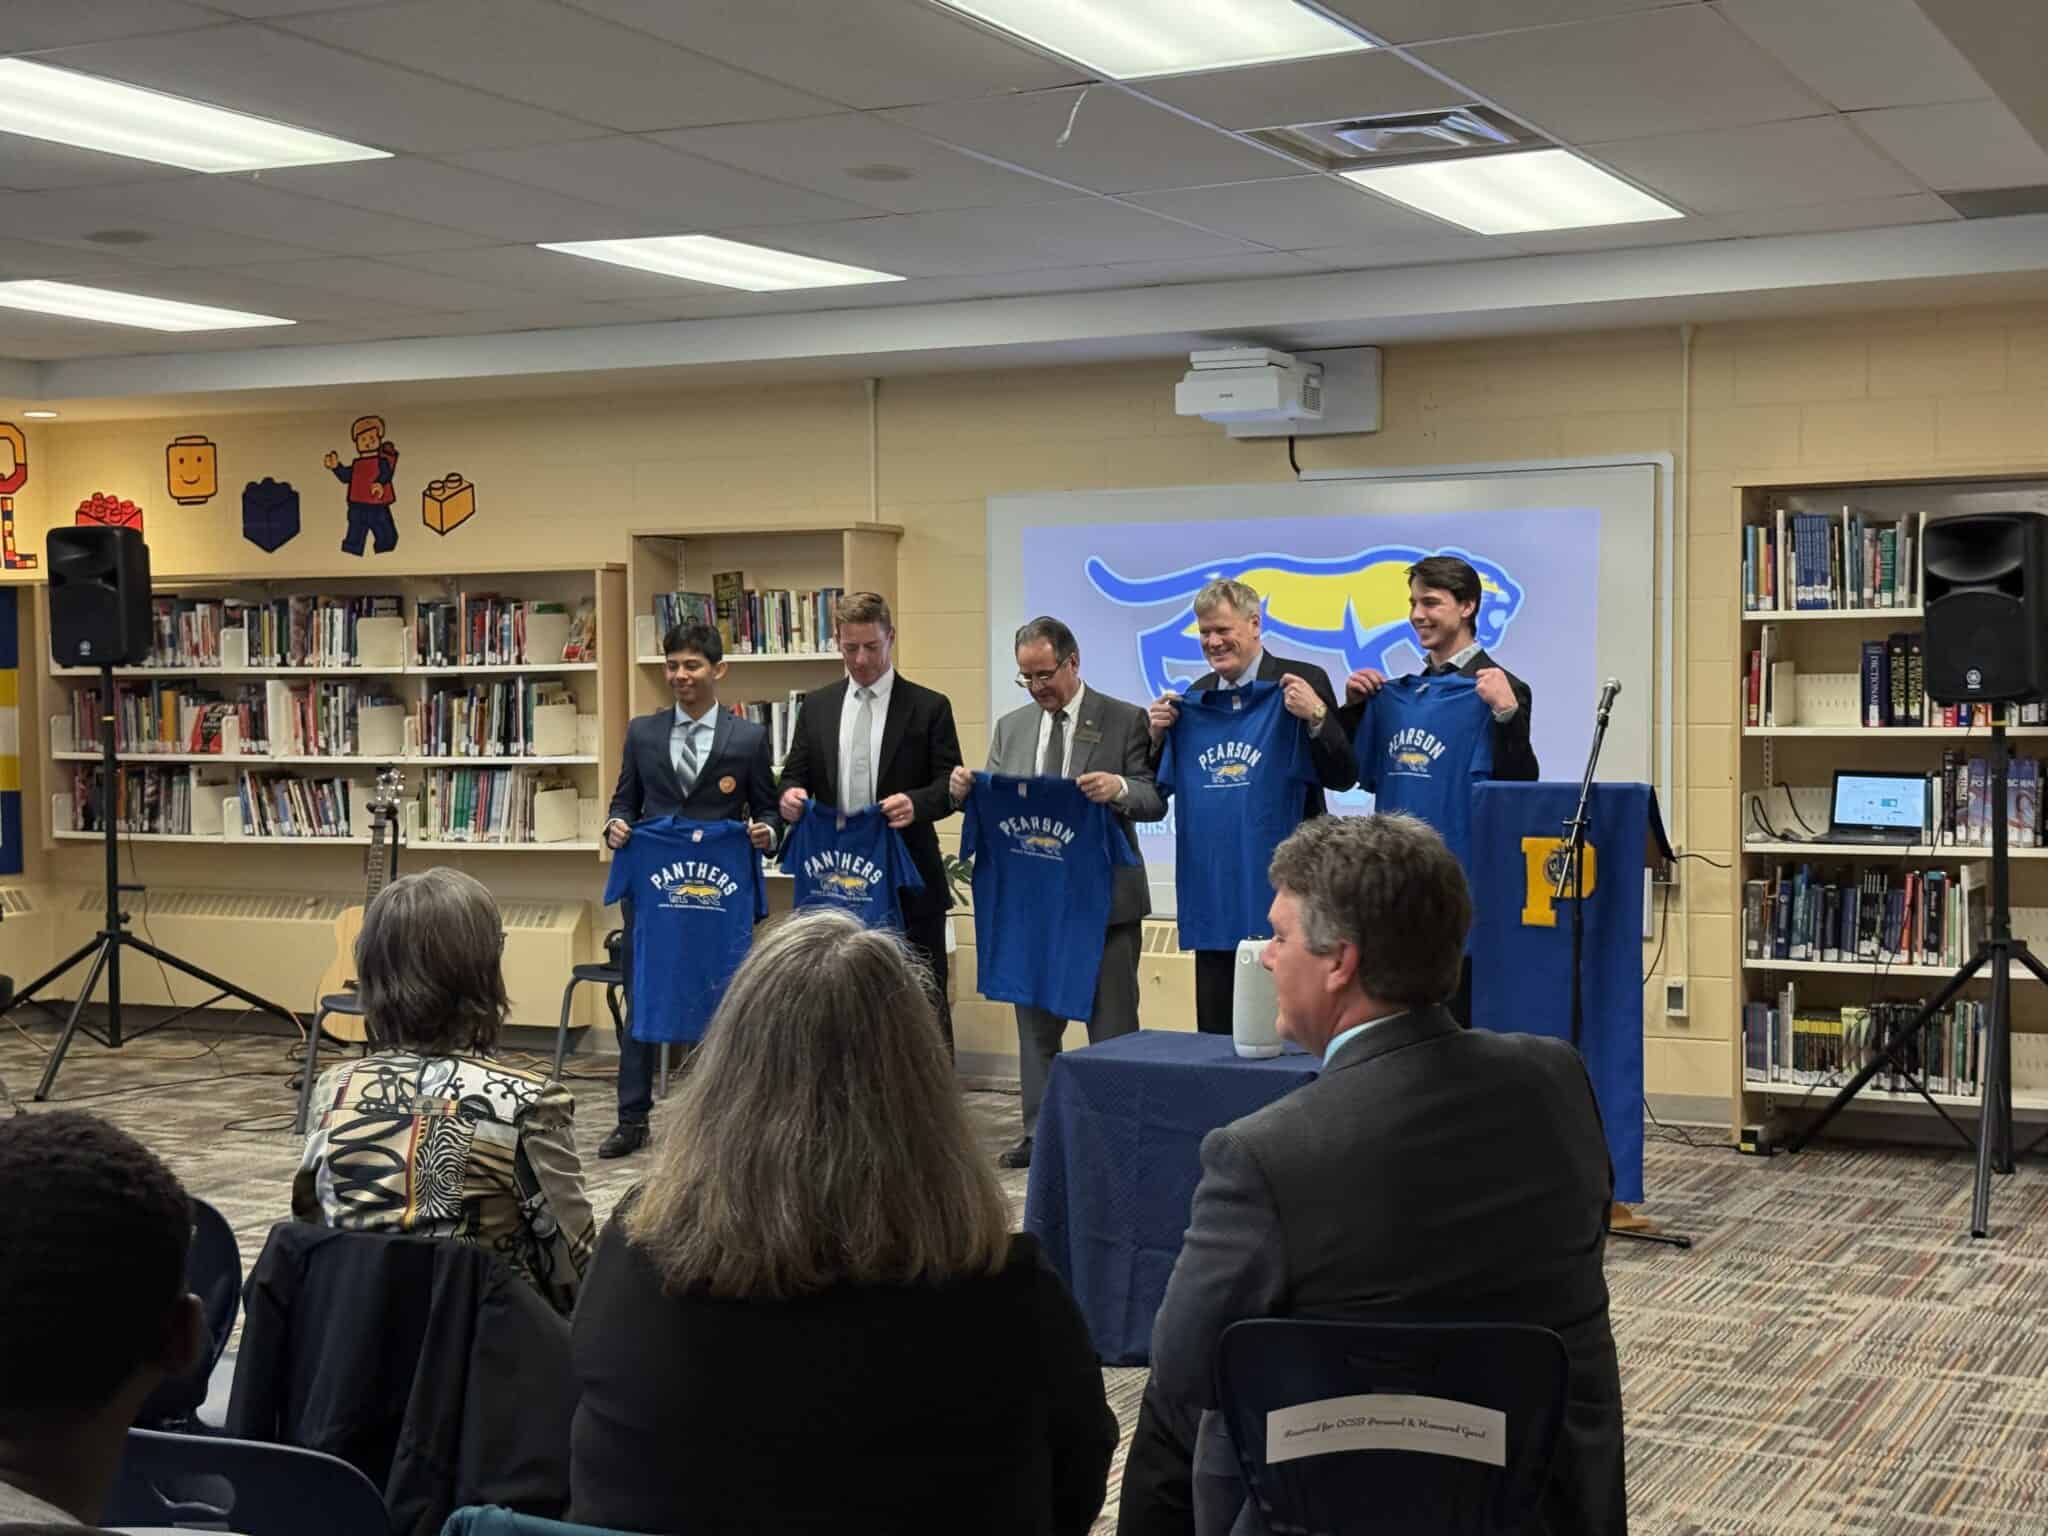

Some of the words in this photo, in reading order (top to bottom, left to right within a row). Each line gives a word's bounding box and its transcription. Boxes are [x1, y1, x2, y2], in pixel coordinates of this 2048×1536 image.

[1198, 741, 1263, 771] PEARSON
[1388, 727, 1446, 761] PEARSON
[999, 815, 1076, 846] PEARSON
[650, 860, 739, 897] PANTHERS
[803, 850, 884, 885] PANTHERS
[1520, 836, 1598, 928] P
